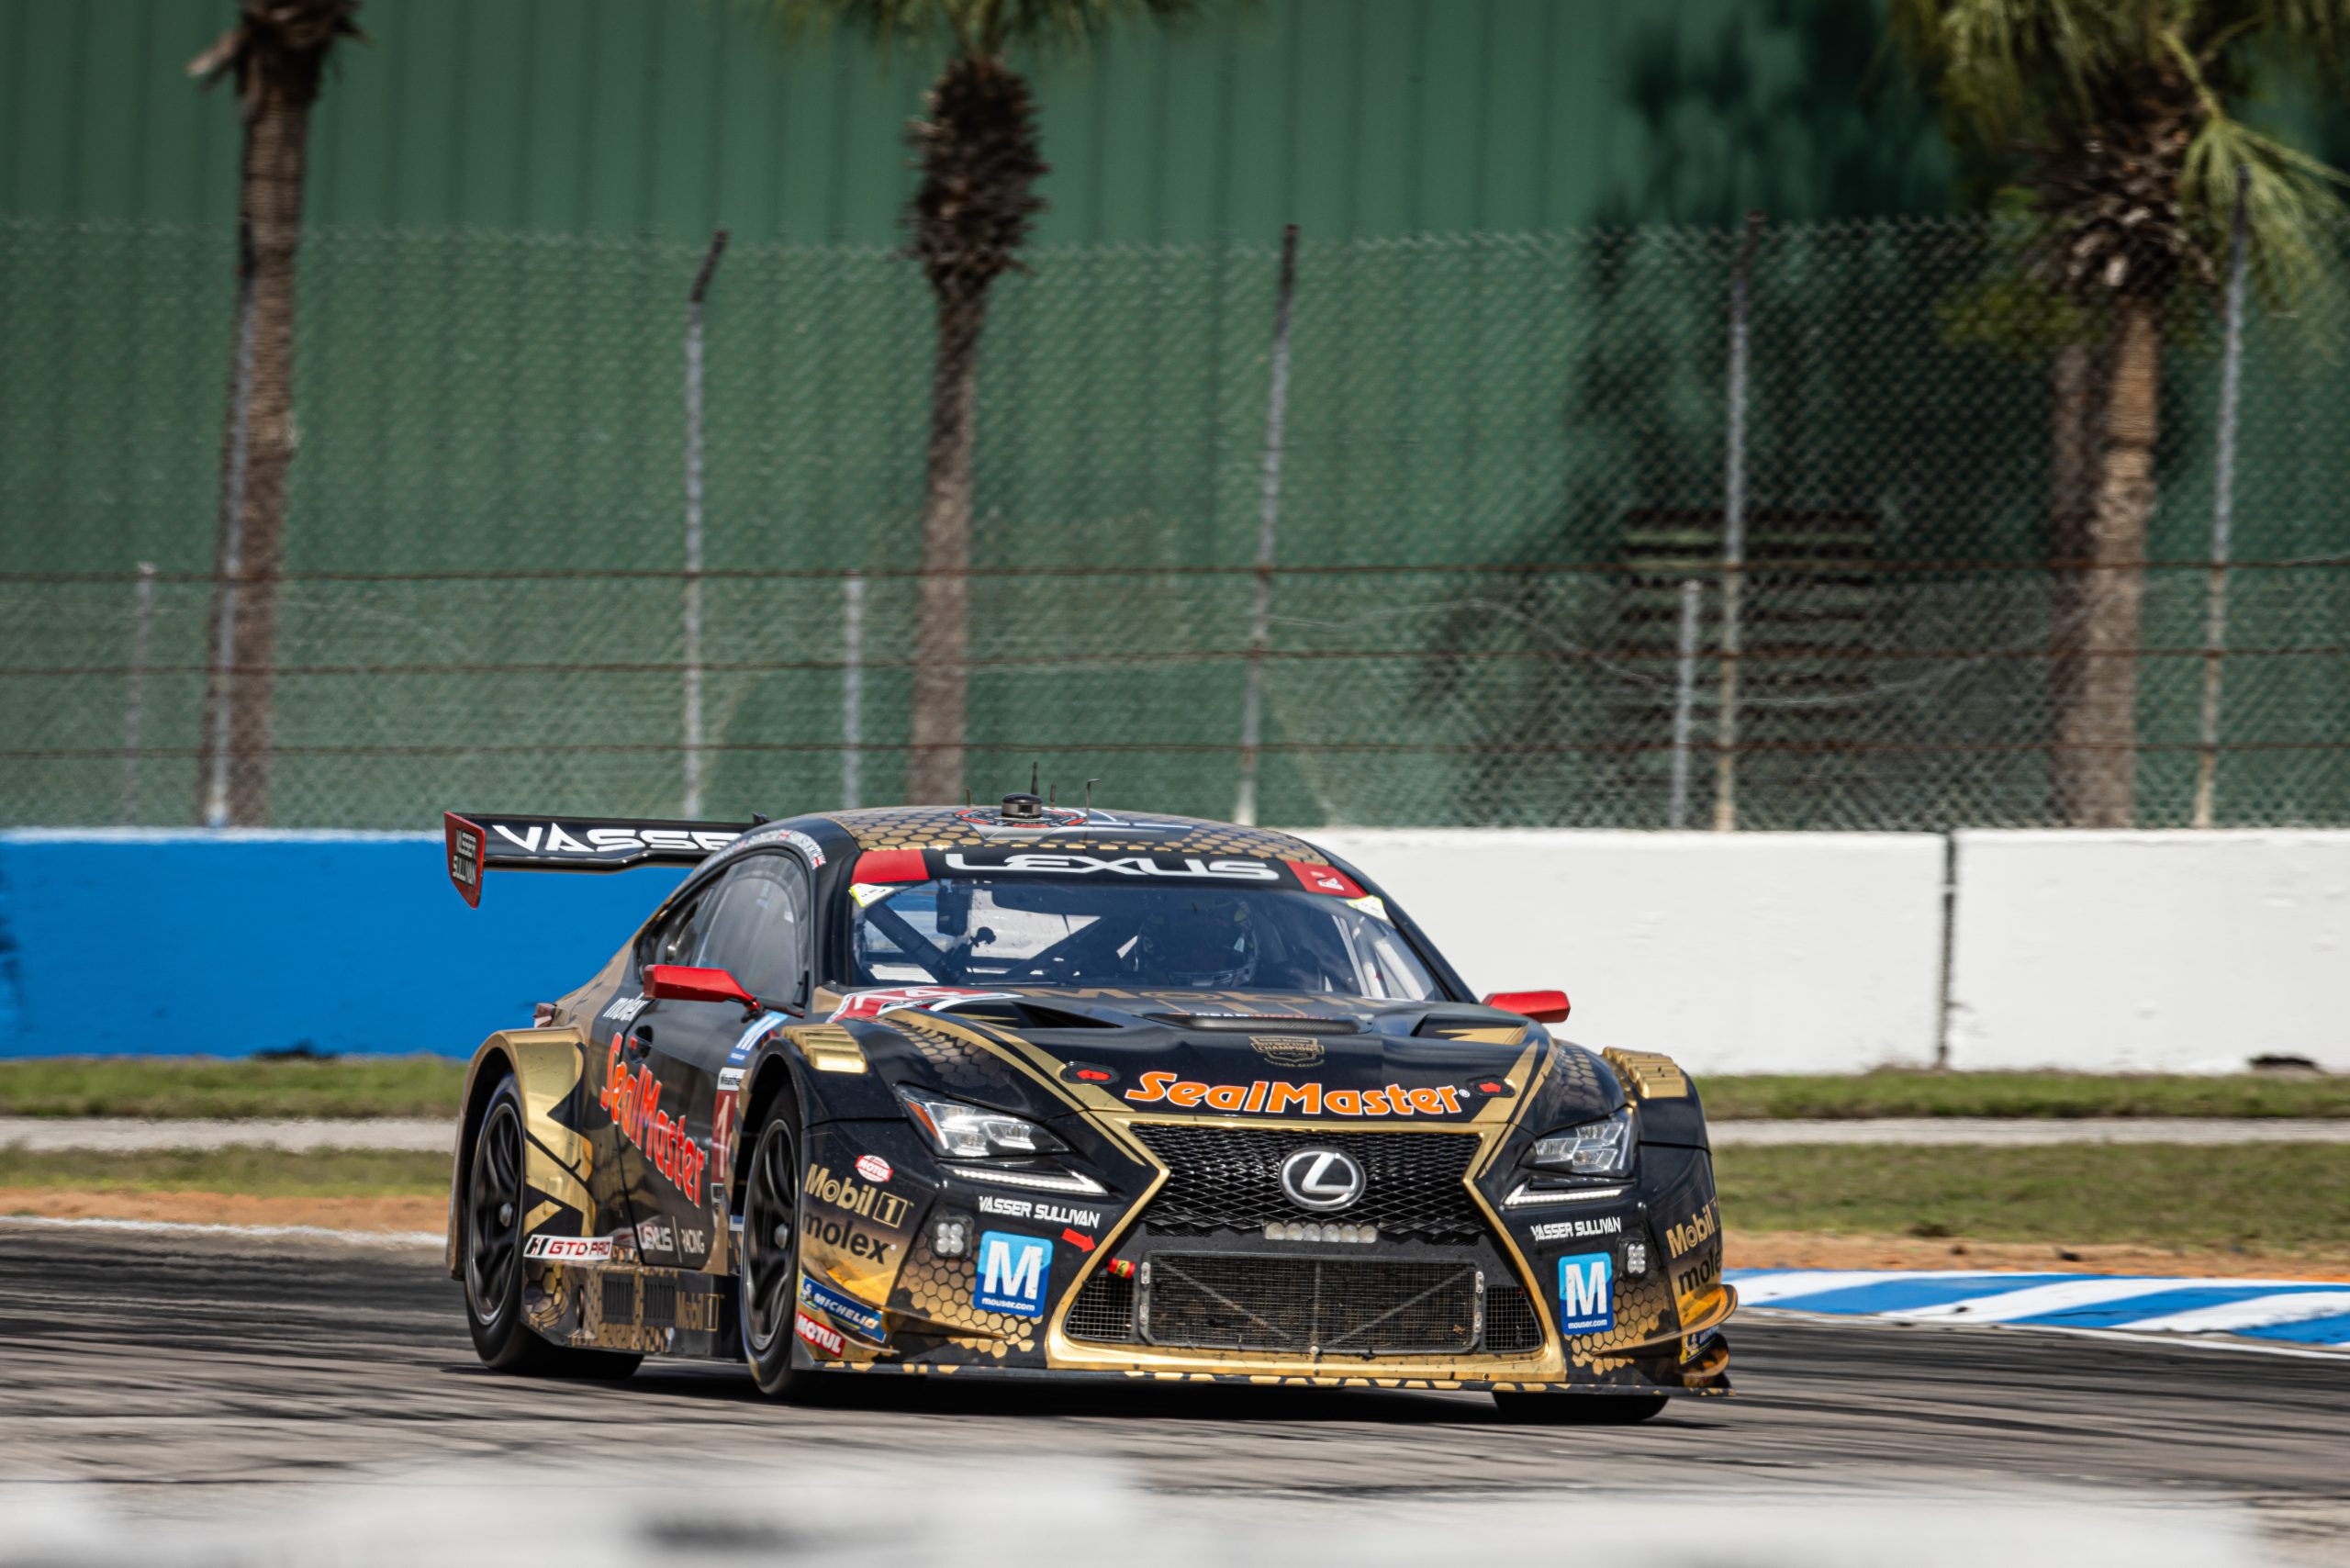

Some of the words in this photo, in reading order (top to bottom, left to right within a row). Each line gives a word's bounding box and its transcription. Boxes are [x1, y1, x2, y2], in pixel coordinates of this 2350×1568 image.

[946, 853, 1280, 880] LEXUS
[1125, 1071, 1463, 1115] SealMaster
[600, 1031, 705, 1209] SealMaster
[804, 1163, 877, 1216] Mobil
[979, 1196, 1032, 1217] VASSER
[1034, 1204, 1101, 1228] SULLIVAN
[1530, 1222, 1574, 1241] VASSER
[1574, 1216, 1622, 1237] SULLIVAN
[1666, 1204, 1715, 1259] Mobil
[548, 1240, 588, 1256] GTD
[590, 1241, 610, 1256] PRO
[803, 1212, 890, 1265] molex
[983, 1240, 1043, 1300] M
[1565, 1261, 1607, 1317] M
[813, 1293, 878, 1329] MICHELIN
[981, 1297, 1035, 1311] mouser.com
[1567, 1318, 1607, 1329] mouser.com
[797, 1314, 842, 1353] MOTUL
